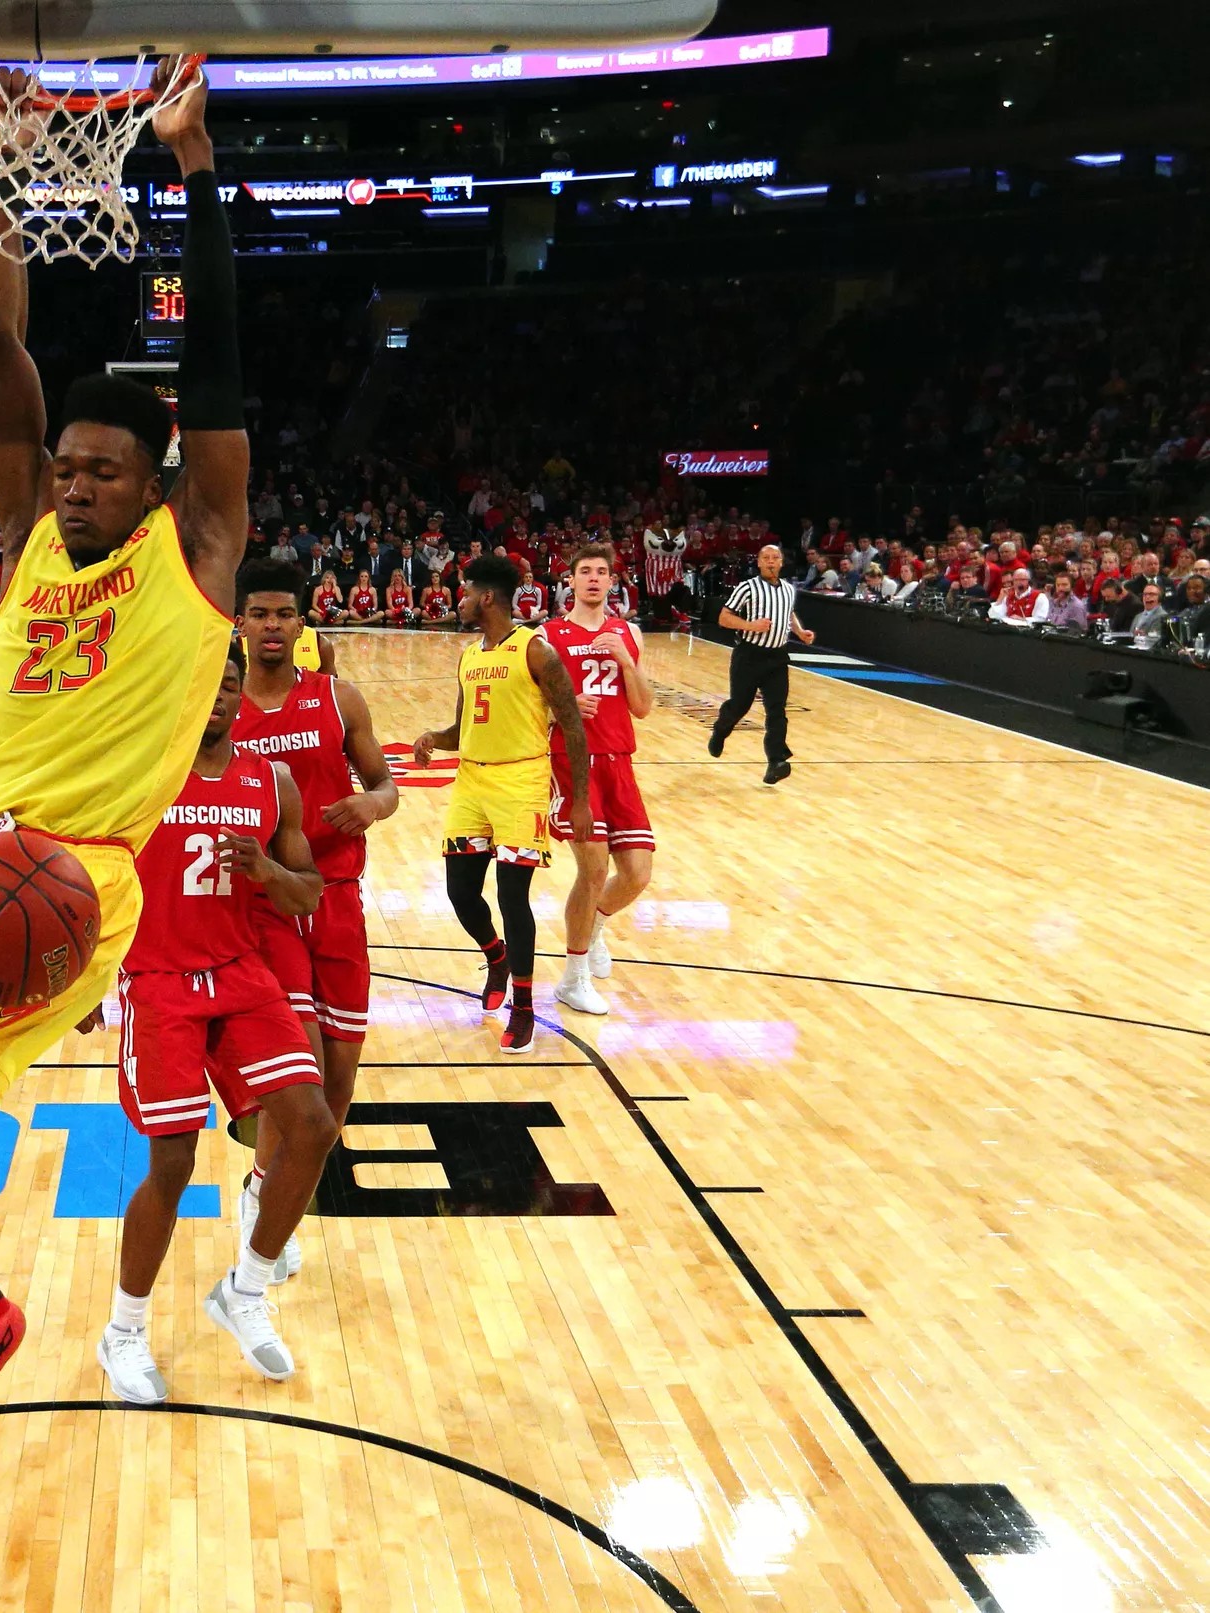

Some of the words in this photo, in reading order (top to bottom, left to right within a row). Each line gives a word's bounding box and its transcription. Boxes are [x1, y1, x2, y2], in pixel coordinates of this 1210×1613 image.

[557, 56, 604, 70] Borrow
[618, 52, 657, 66] Invest
[672, 48, 704, 62] Save
[739, 44, 771, 60] SoFi
[235, 69, 286, 82] Personal
[288, 69, 334, 82] Finance
[335, 67, 351, 80] To
[369, 67, 399, 79] Your
[471, 64, 501, 78] SoFi
[680, 161, 777, 183] /THEGARDEN
[153, 191, 187, 205] 15:2
[253, 185, 343, 202] WISCONSIN
[550, 181, 562, 195] 5
[153, 277, 182, 293] 15:2
[665, 452, 769, 475] Budweiser
[21, 566, 136, 615] MARYLAND
[9, 606, 116, 695] 23
[464, 666, 509, 682] MARYLAND
[581, 659, 619, 696] 22
[473, 685, 491, 724] 5
[161, 806, 262, 828] WISCONSIN
[183, 833, 233, 896] 21
